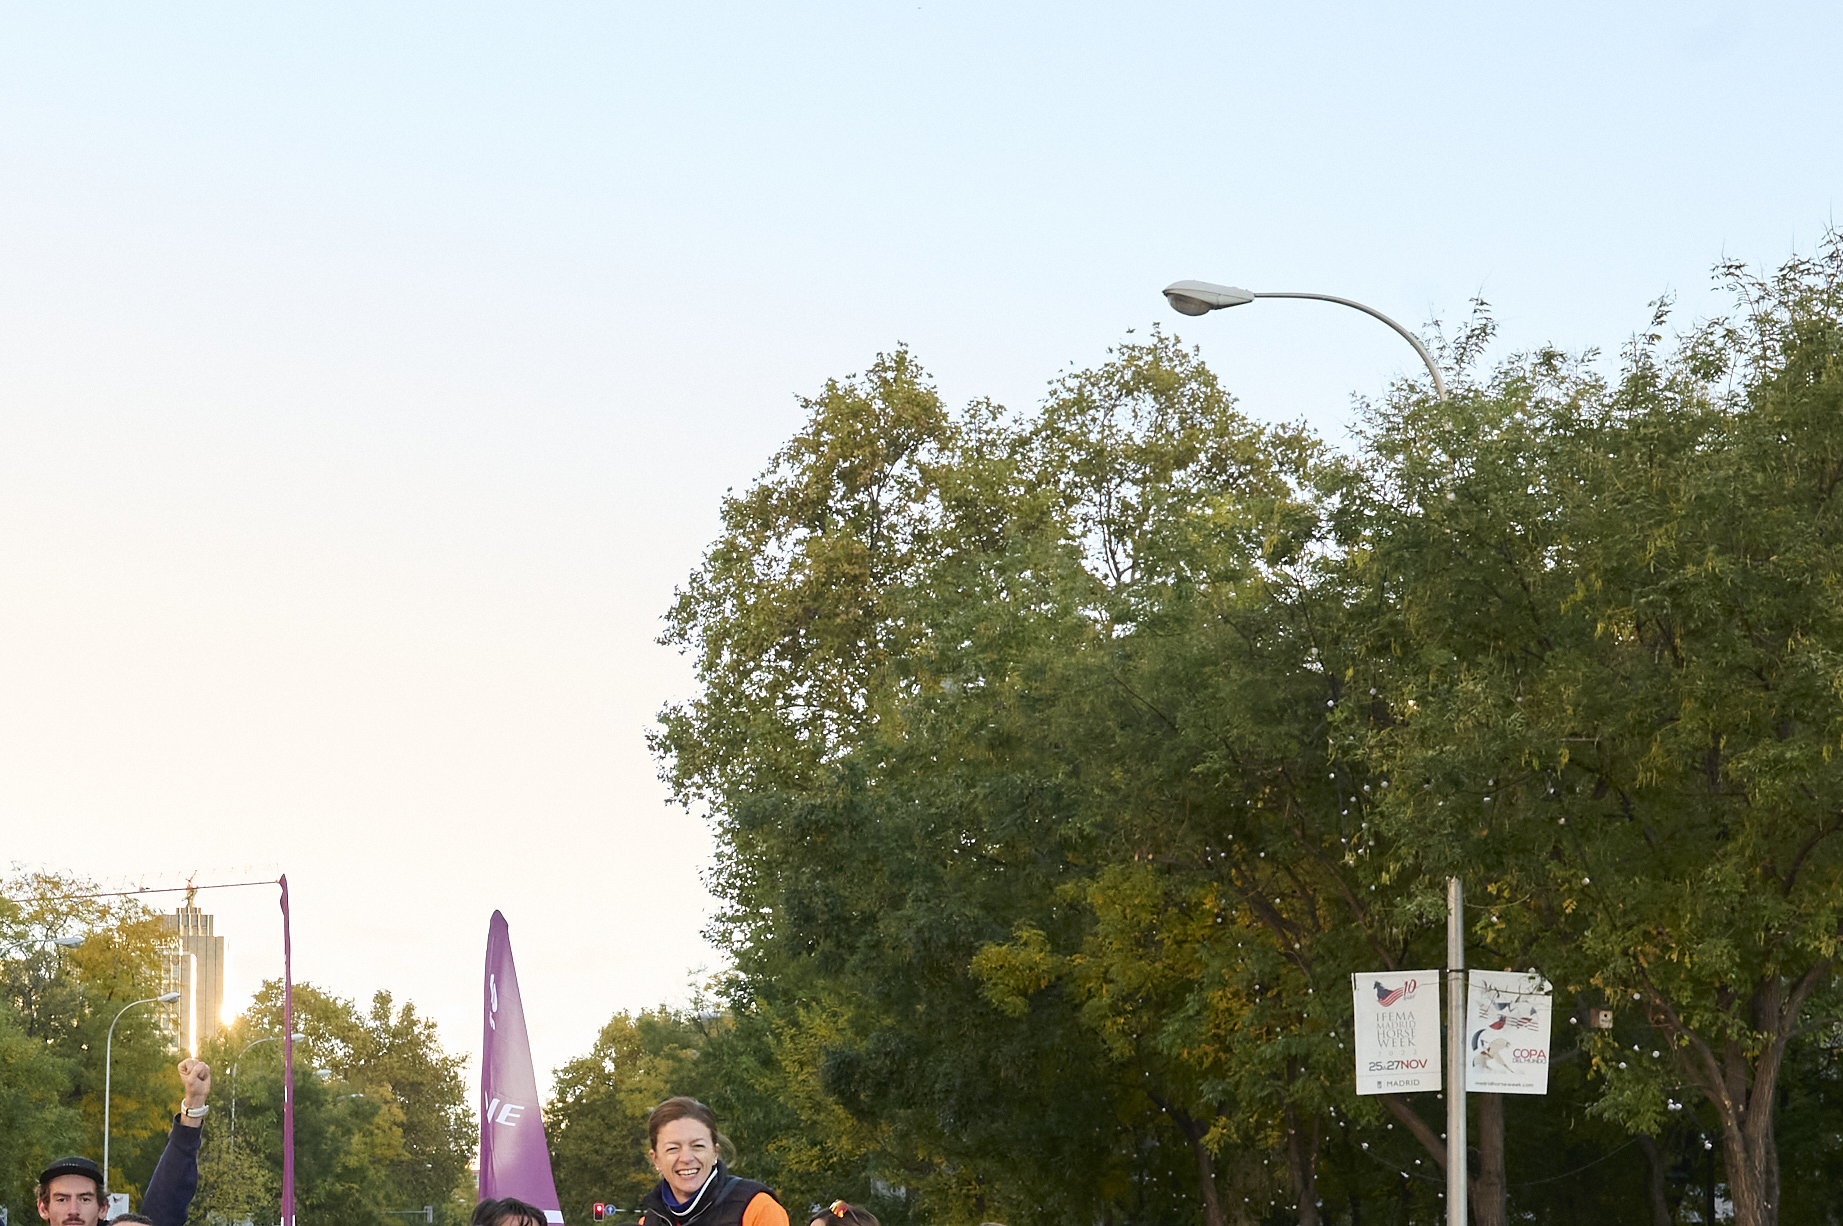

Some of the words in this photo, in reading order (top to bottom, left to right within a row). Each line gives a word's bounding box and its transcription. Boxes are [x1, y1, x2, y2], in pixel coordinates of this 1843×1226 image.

[1403, 978, 1418, 997] 10
[1376, 1011, 1415, 1022] IFEMA
[1376, 1020, 1417, 1030] MADRID
[1377, 1029, 1416, 1040] HORSE
[1377, 1037, 1417, 1048] WEEK
[1512, 1048, 1547, 1059] COPA
[1386, 1079, 1420, 1087] MADRID
